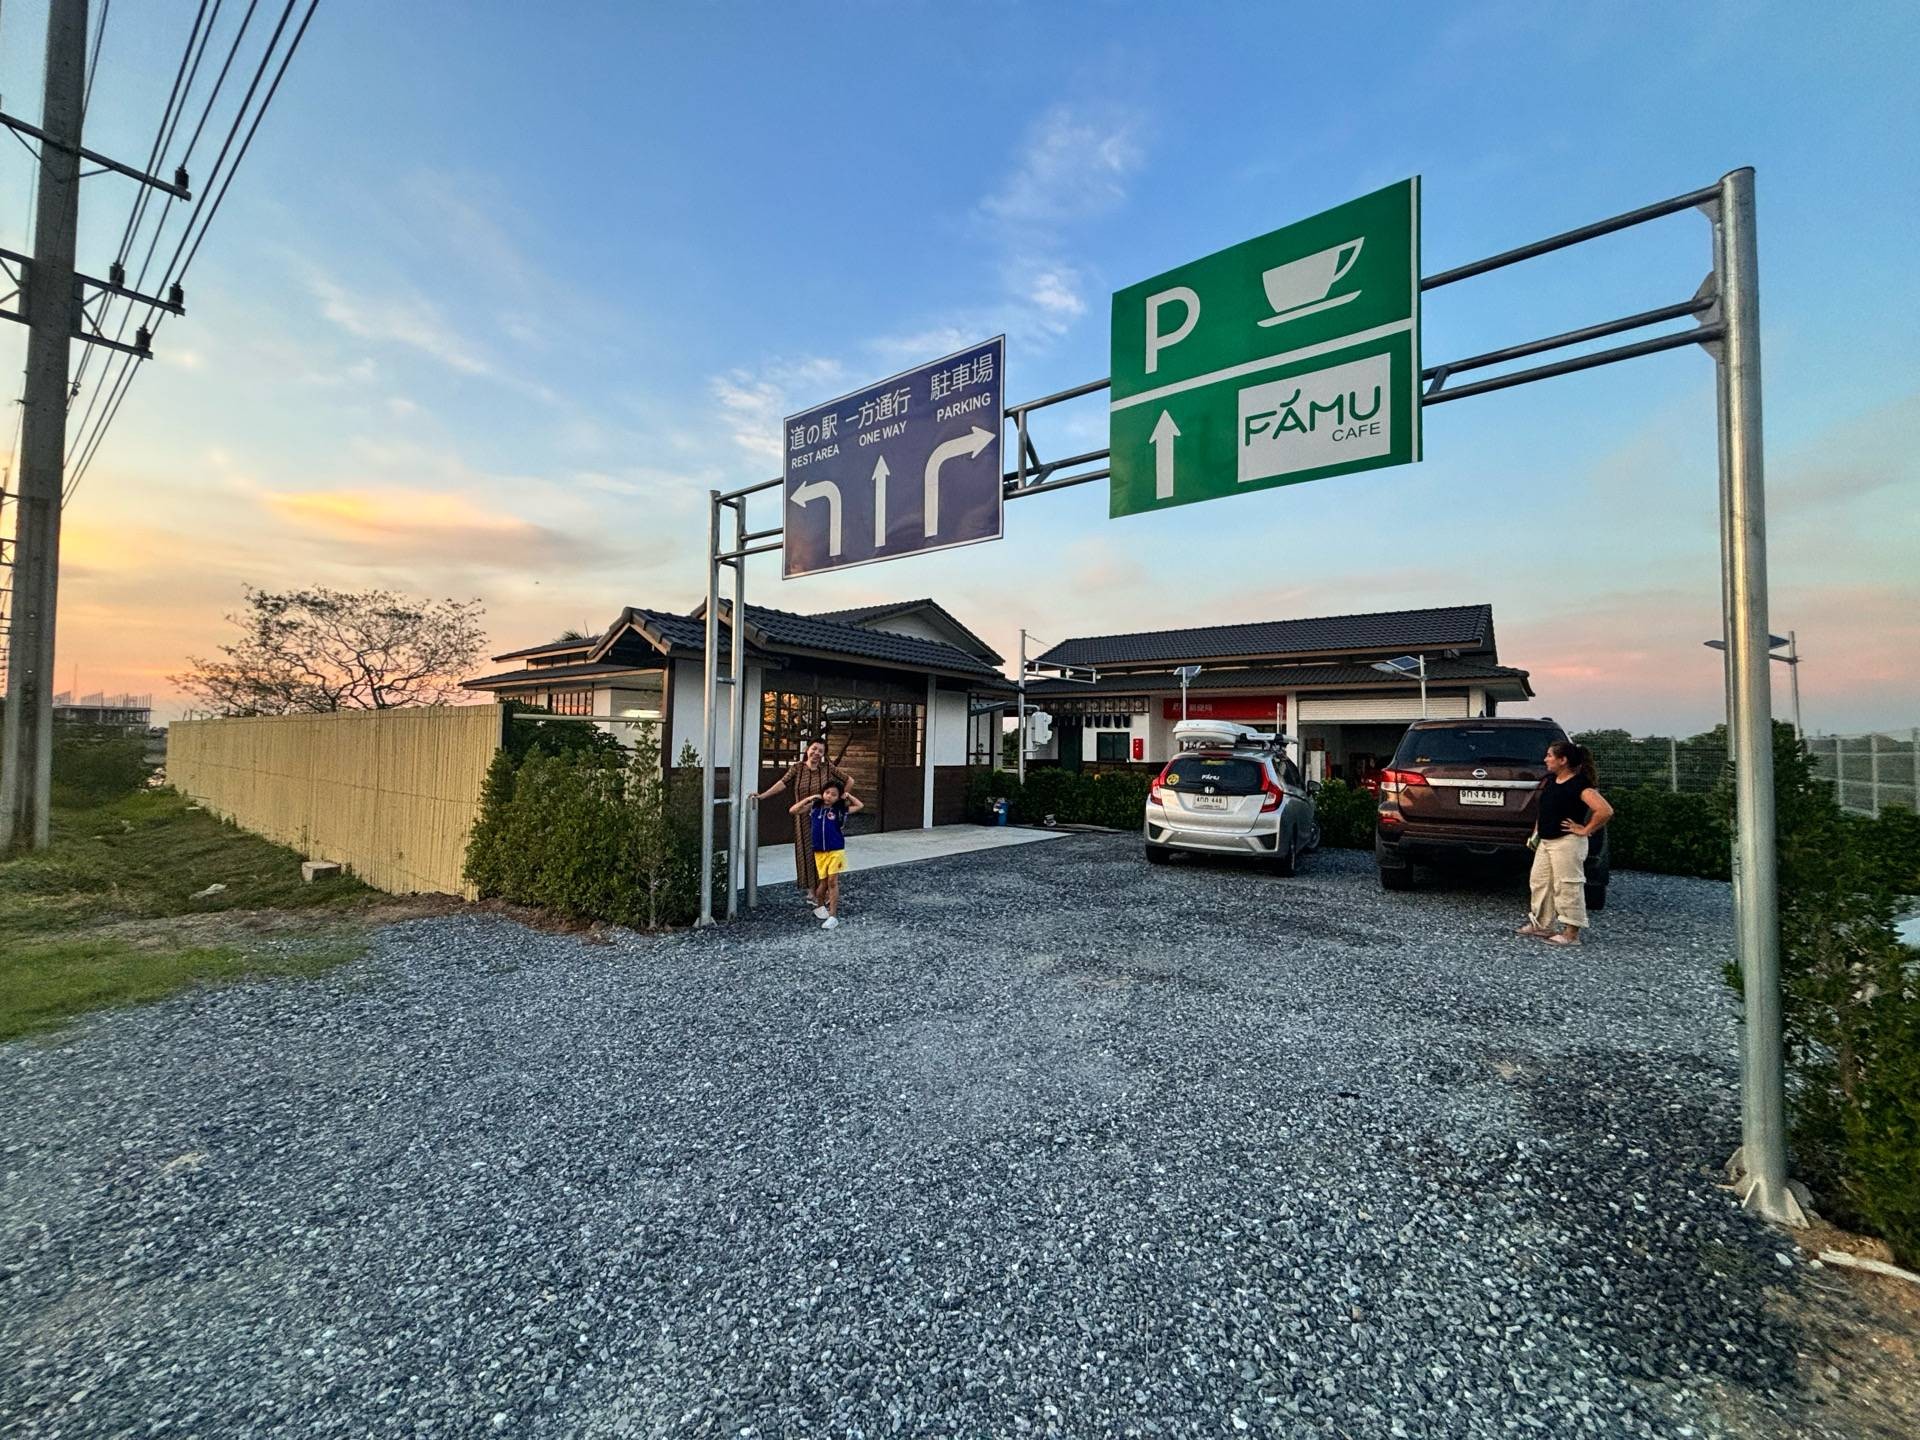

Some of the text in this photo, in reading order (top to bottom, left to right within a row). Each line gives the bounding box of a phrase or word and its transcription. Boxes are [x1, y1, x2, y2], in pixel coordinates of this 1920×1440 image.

[1145, 286, 1201, 375] P
[930, 353, 993, 401] 駐車場
[845, 386, 912, 430] 一方通行
[936, 392, 991, 423] PARKING
[789, 413, 838, 452] 道の駅
[858, 420, 907, 447] ONE WAY
[1331, 421, 1381, 442] CAFE
[791, 444, 839, 470] REST AREA
